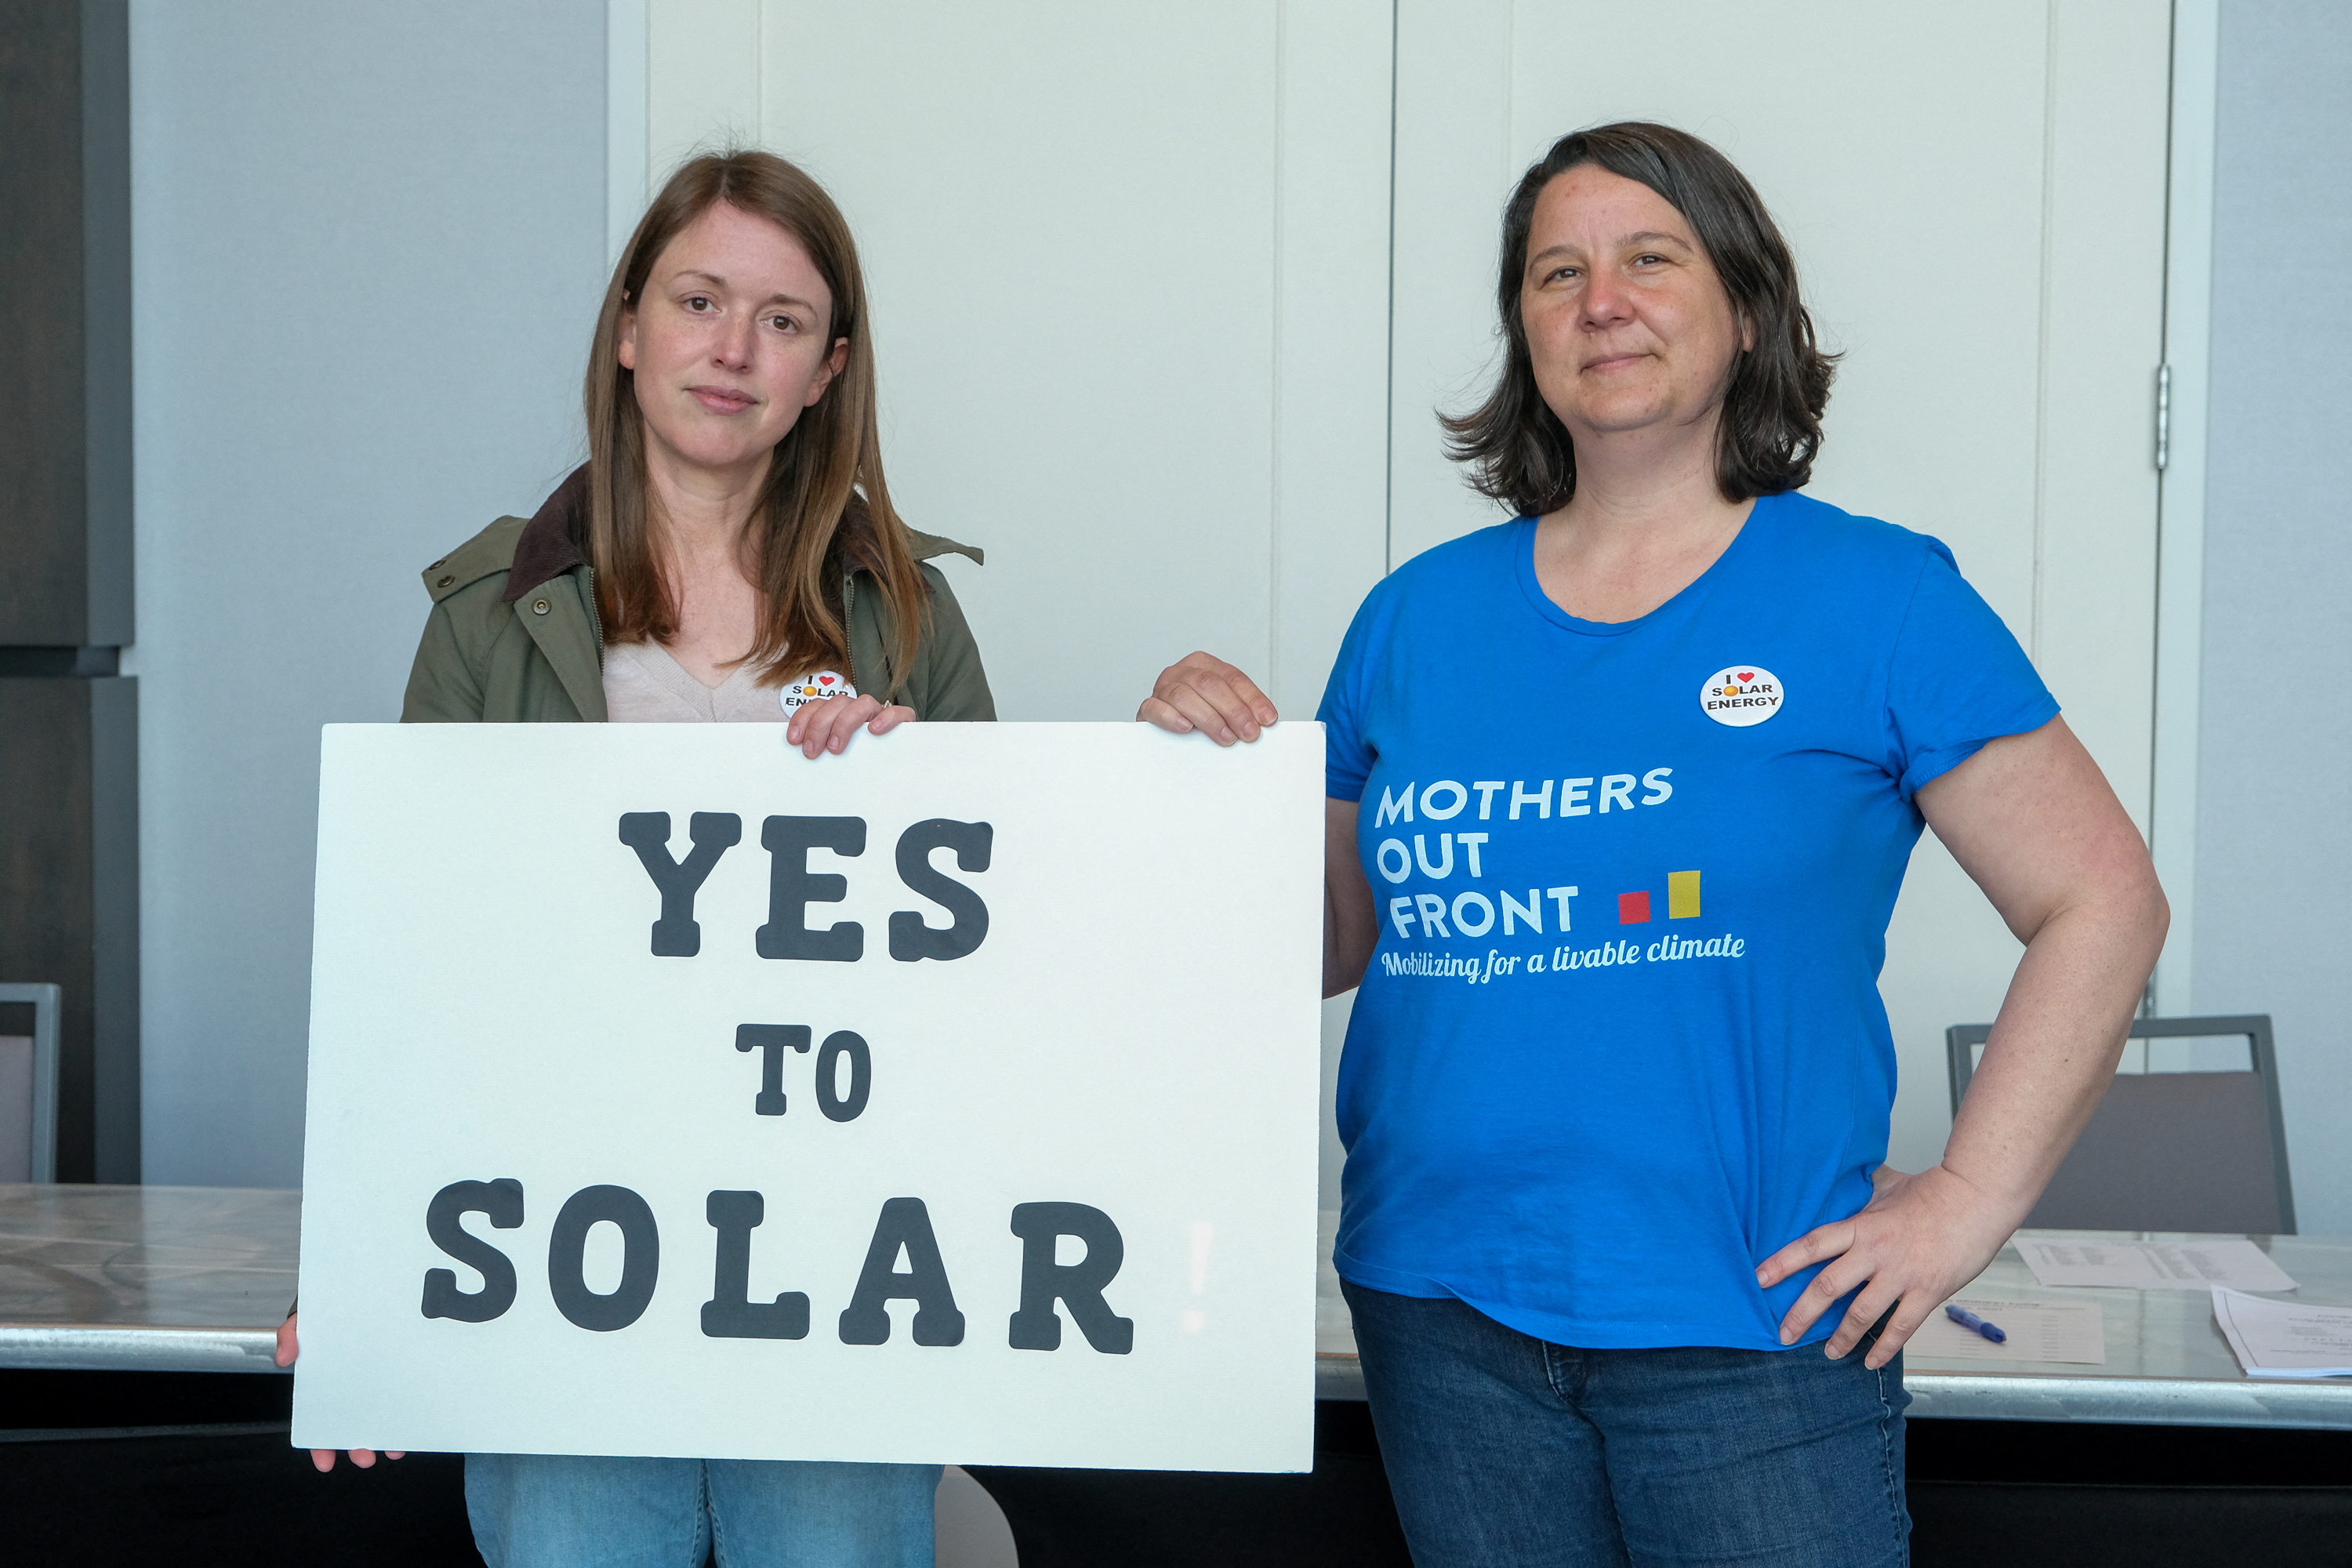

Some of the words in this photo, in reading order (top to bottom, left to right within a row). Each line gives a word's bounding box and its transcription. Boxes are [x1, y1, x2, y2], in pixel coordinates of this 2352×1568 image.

[808, 675, 813, 684] I
[1707, 696, 1779, 710] ENERGY
[1711, 684, 1773, 697] SOLAR
[1726, 674, 1731, 684] I
[1374, 767, 1673, 829] MOTHERS
[1377, 832, 1489, 884] OUT
[619, 812, 993, 963] YES
[1389, 885, 1579, 938] FRONT
[1381, 951, 1482, 985] Mobilizing
[1480, 949, 1522, 984] for
[1526, 953, 1547, 973] a
[1552, 939, 1641, 971] livable
[1646, 933, 1745, 962] climate
[735, 1024, 872, 1123] TO
[421, 1178, 1134, 1356] SOLAR
